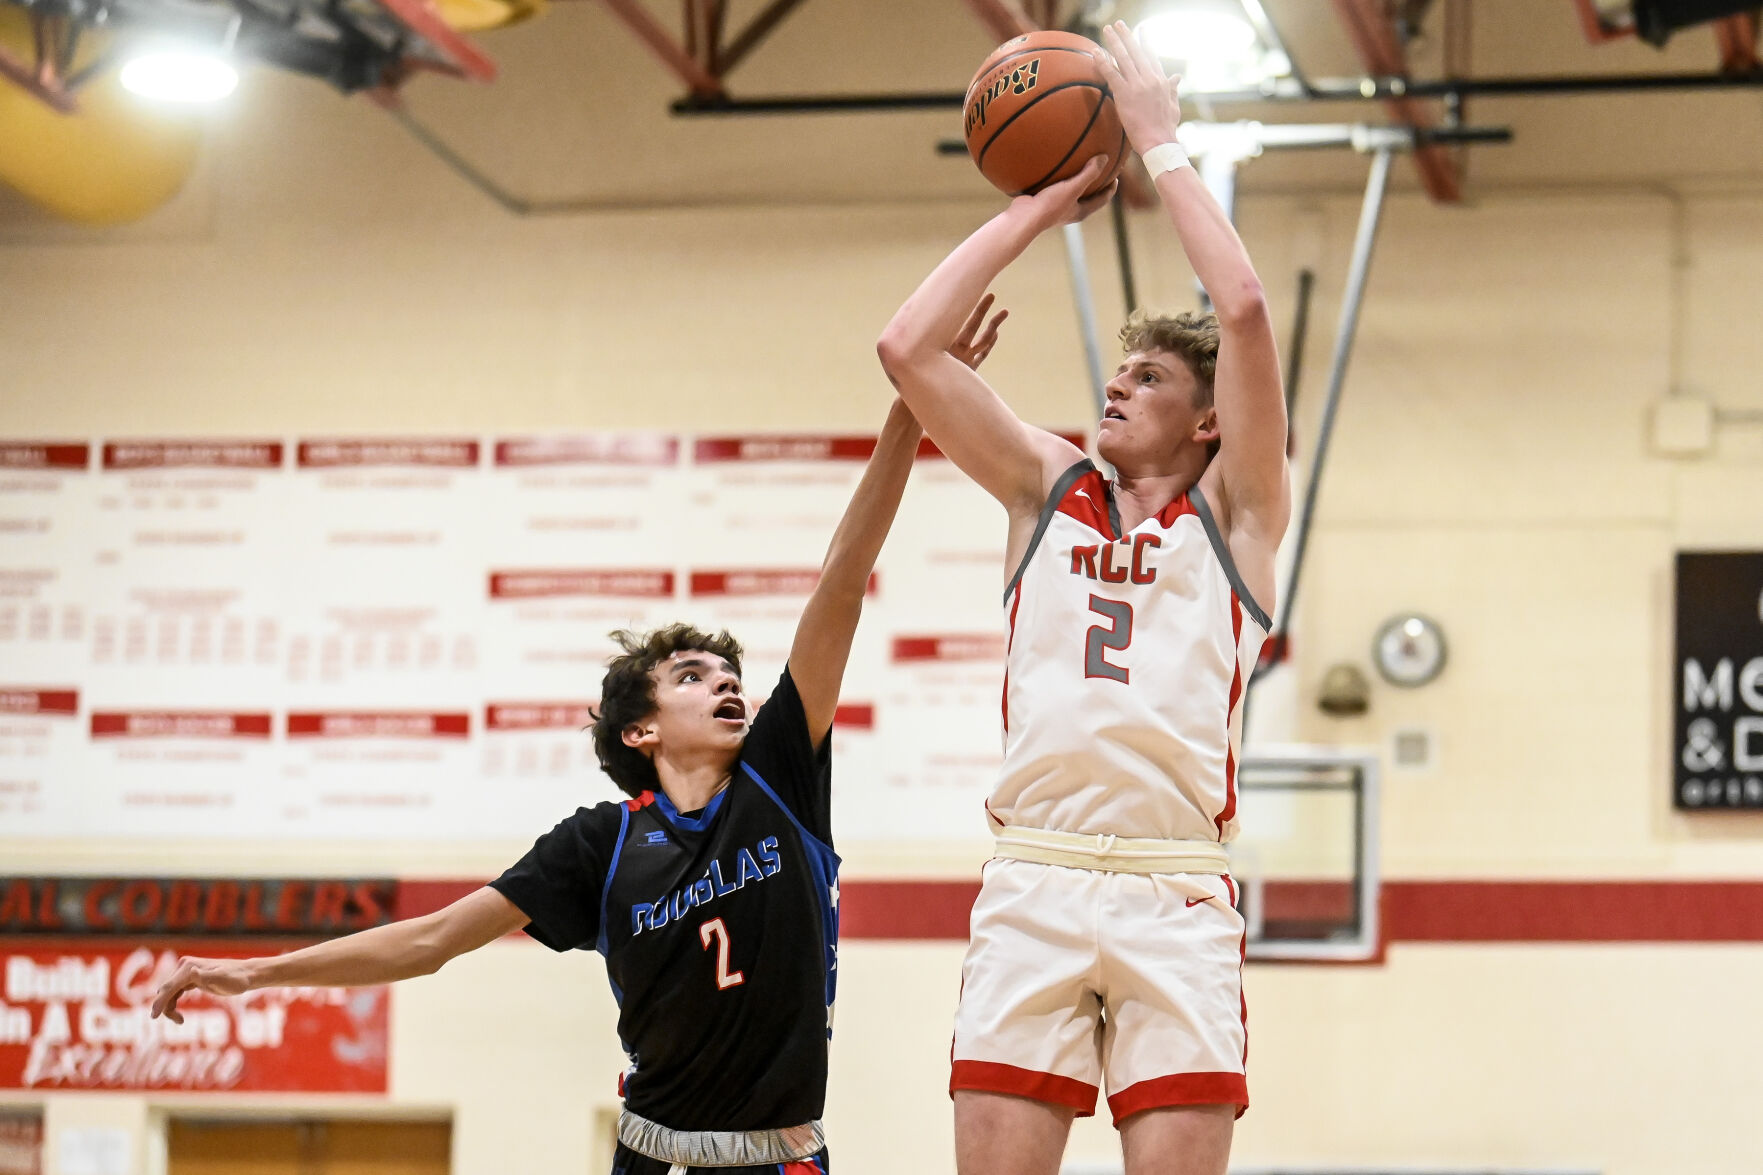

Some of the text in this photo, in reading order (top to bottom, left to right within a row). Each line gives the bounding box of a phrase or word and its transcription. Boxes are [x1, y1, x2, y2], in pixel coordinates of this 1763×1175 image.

[964, 58, 1040, 139] Baden
[1070, 533, 1162, 585] RCC
[1085, 593, 1134, 685] 2
[83, 879, 381, 930] COBBLERS
[631, 835, 781, 936] DOUGLAS
[6, 956, 110, 1001] Build
[699, 917, 745, 990] 2
[235, 1003, 286, 1049] of
[22, 1040, 246, 1088] Excellence
